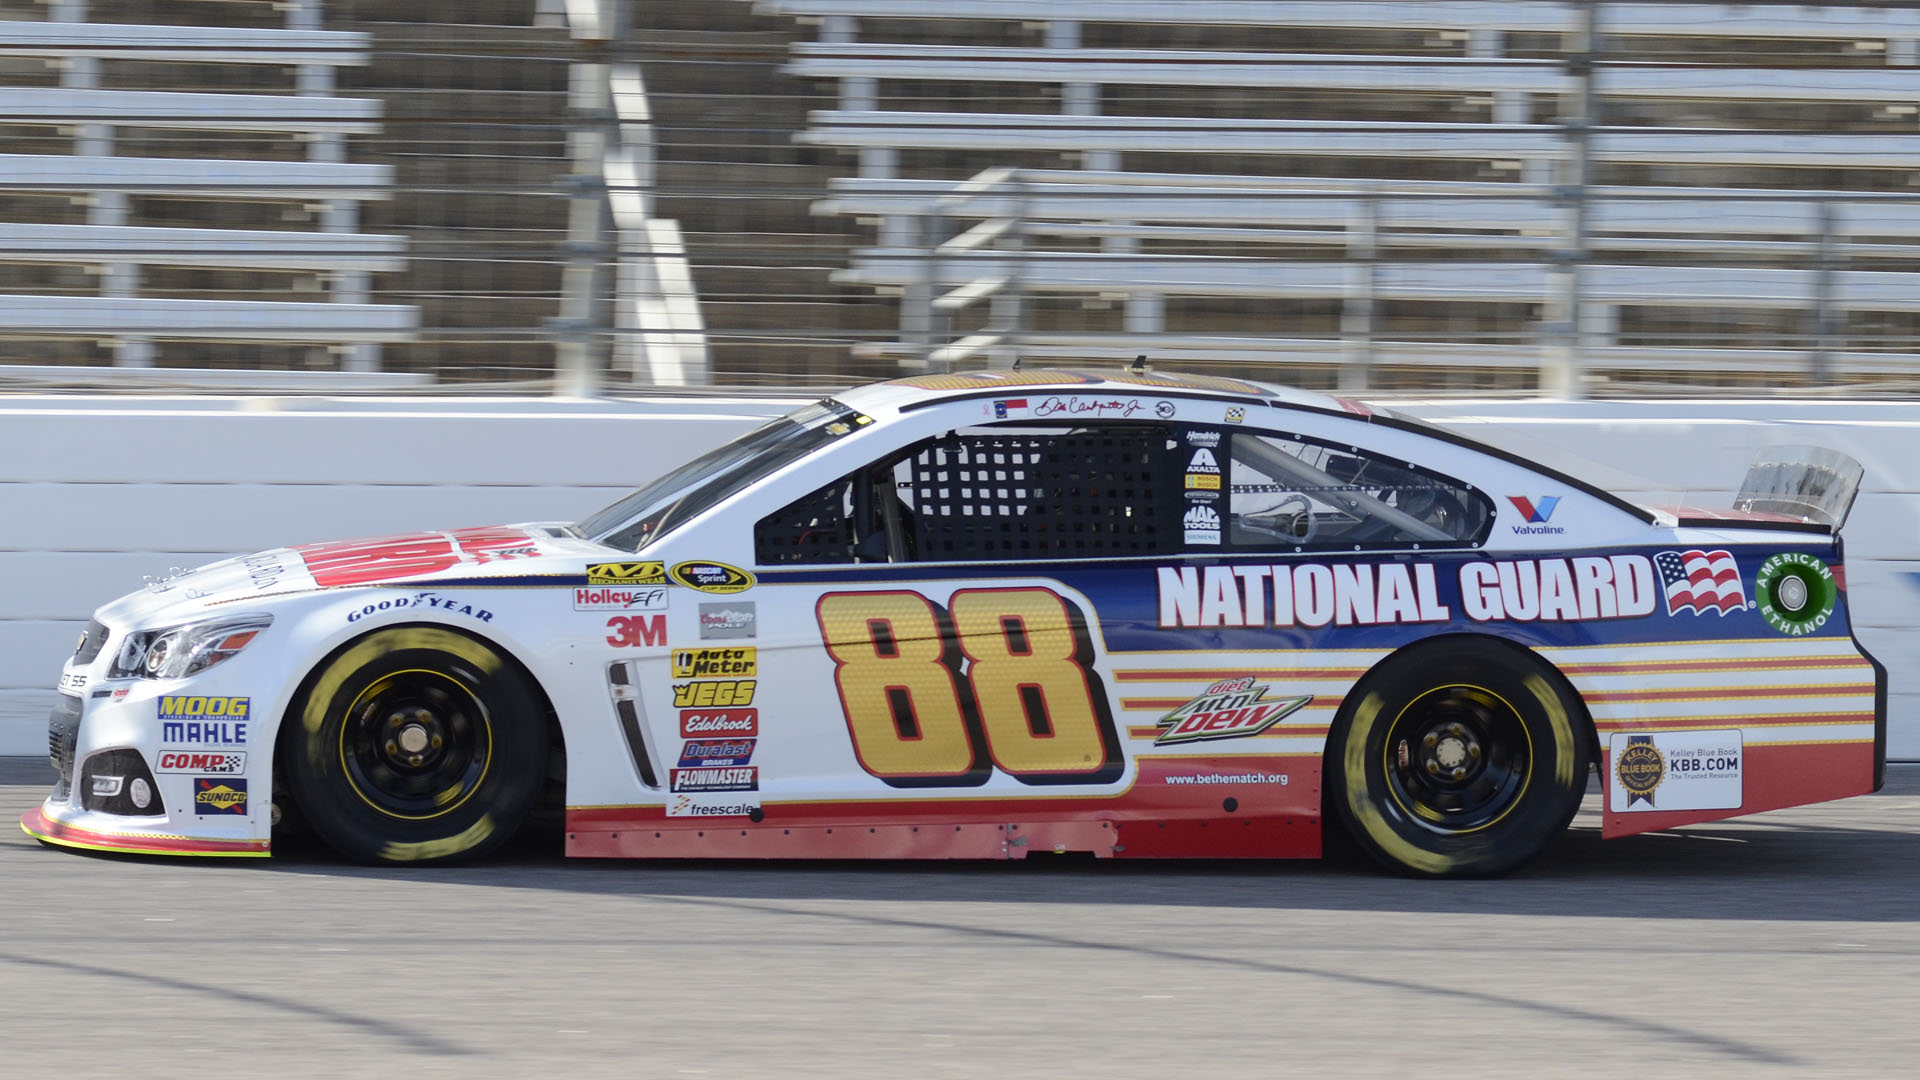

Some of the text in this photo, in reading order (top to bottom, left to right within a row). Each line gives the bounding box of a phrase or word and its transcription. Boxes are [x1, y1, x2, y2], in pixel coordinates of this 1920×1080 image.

[1186, 430, 1221, 441] Hendrick
[1184, 505, 1220, 523] MAC
[1512, 526, 1564, 534] Valvoline
[1757, 553, 1833, 589] AMERICAN
[588, 576, 666, 585] MECHANIX WEAR
[698, 575, 727, 583] Sprint
[577, 589, 665, 608] Holley EFI
[1155, 554, 1657, 628] NATIONAL GUARD
[1761, 604, 1833, 636] ETHANOL
[606, 615, 668, 648] 3M
[697, 650, 744, 660] Auto
[693, 660, 754, 674] Meter
[815, 586, 1110, 782] 88
[1209, 679, 1248, 695] diet
[674, 681, 757, 708] JEGS
[160, 697, 248, 716] MOOG
[685, 714, 753, 733] Edelbrock
[163, 723, 247, 743] MAHLE
[685, 742, 752, 757] Duralast
[1625, 749, 1658, 762] KELLEY
[1670, 750, 1695, 758] Kelley
[1718, 748, 1738, 756] Book
[161, 754, 225, 769] COMP
[1621, 764, 1661, 774] BLUE BOOK
[1670, 758, 1738, 772] KBB.COM
[674, 769, 753, 791] FLOWMASTER
[1165, 773, 1288, 785] www.bethematch.org
[198, 793, 246, 802] SUNOCO
[690, 803, 753, 815] freescale
